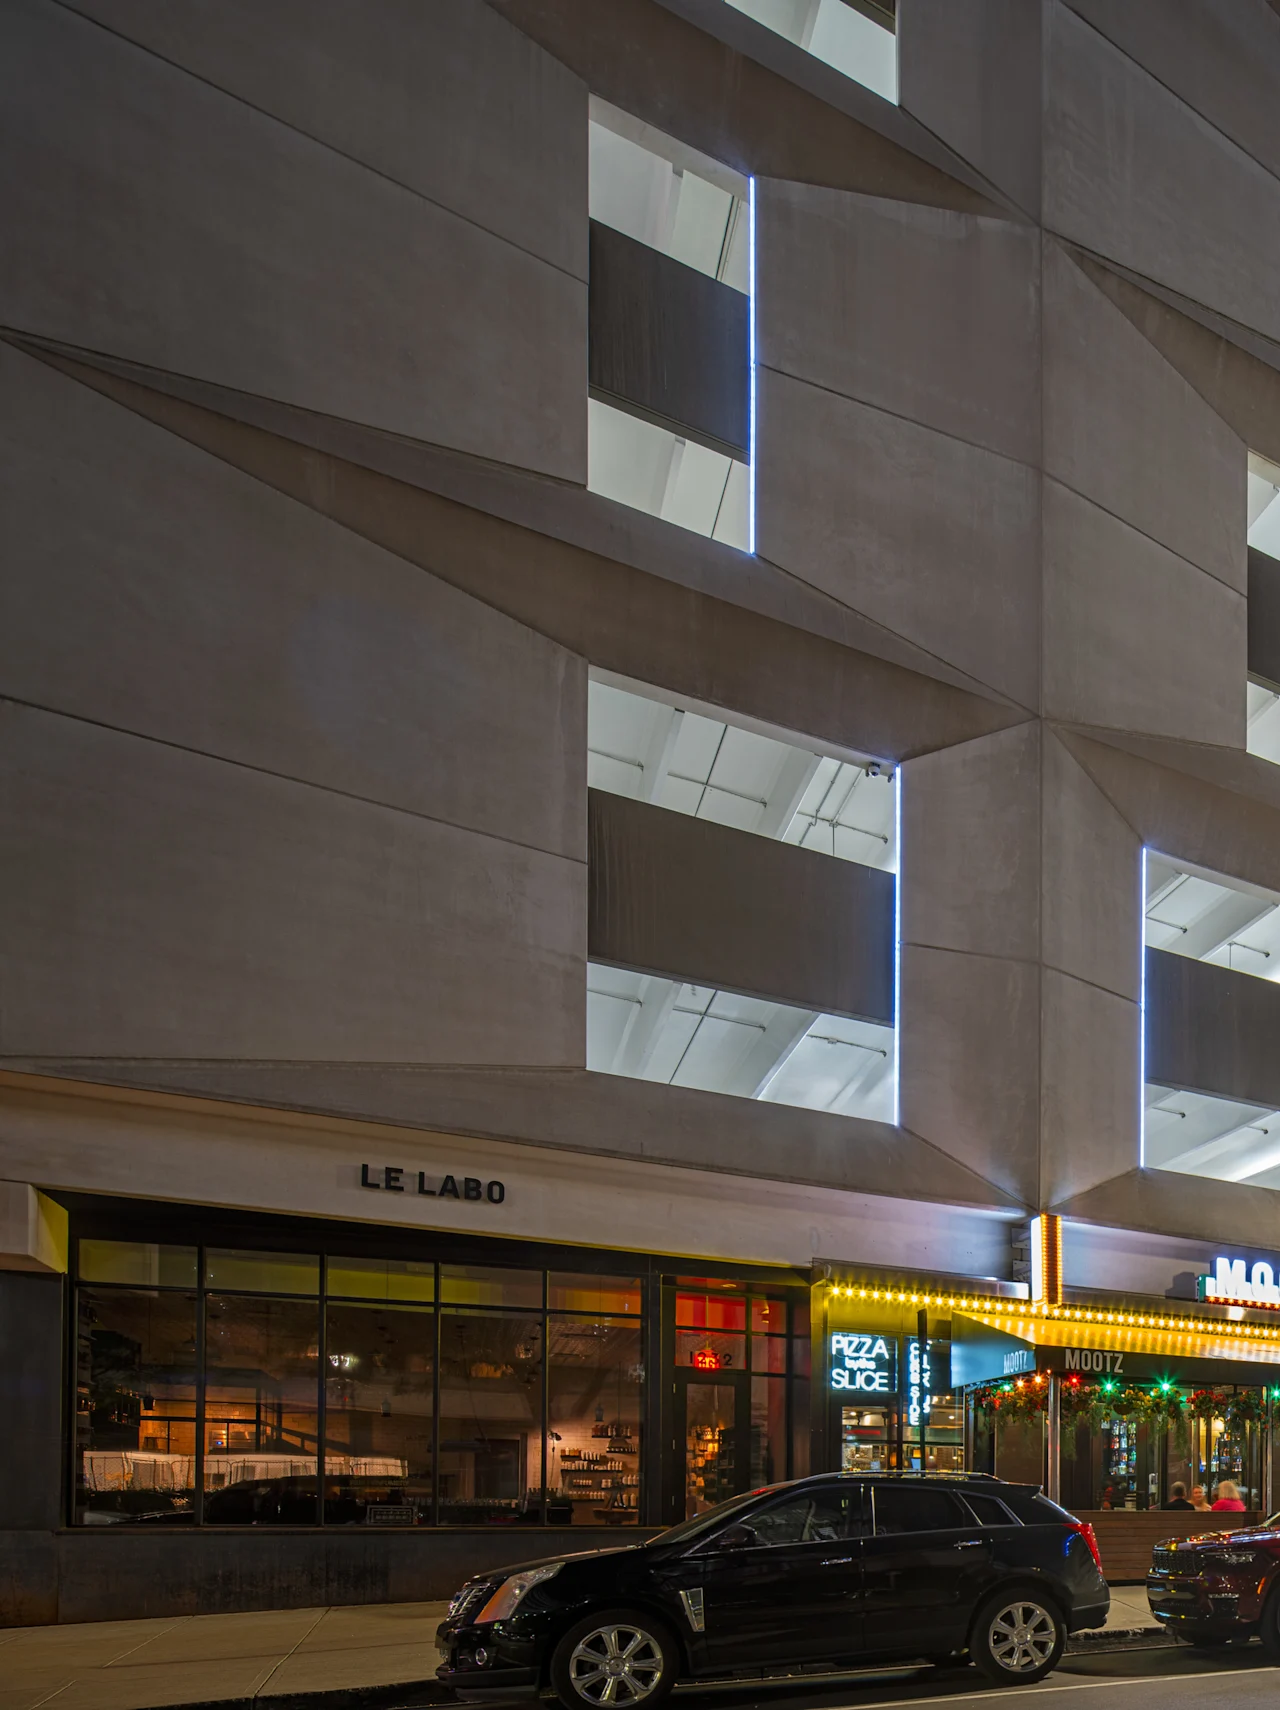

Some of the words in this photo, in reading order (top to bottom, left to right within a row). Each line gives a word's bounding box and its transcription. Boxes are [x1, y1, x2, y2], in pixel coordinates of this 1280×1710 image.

[361, 1163, 404, 1191] LE
[418, 1171, 505, 1204] LABO
[831, 1335, 889, 1359] PIZZA
[1003, 1350, 1028, 1374] MOOTZ
[1065, 1348, 1124, 1374] MOOTZ
[831, 1368, 889, 1391] SLICE
